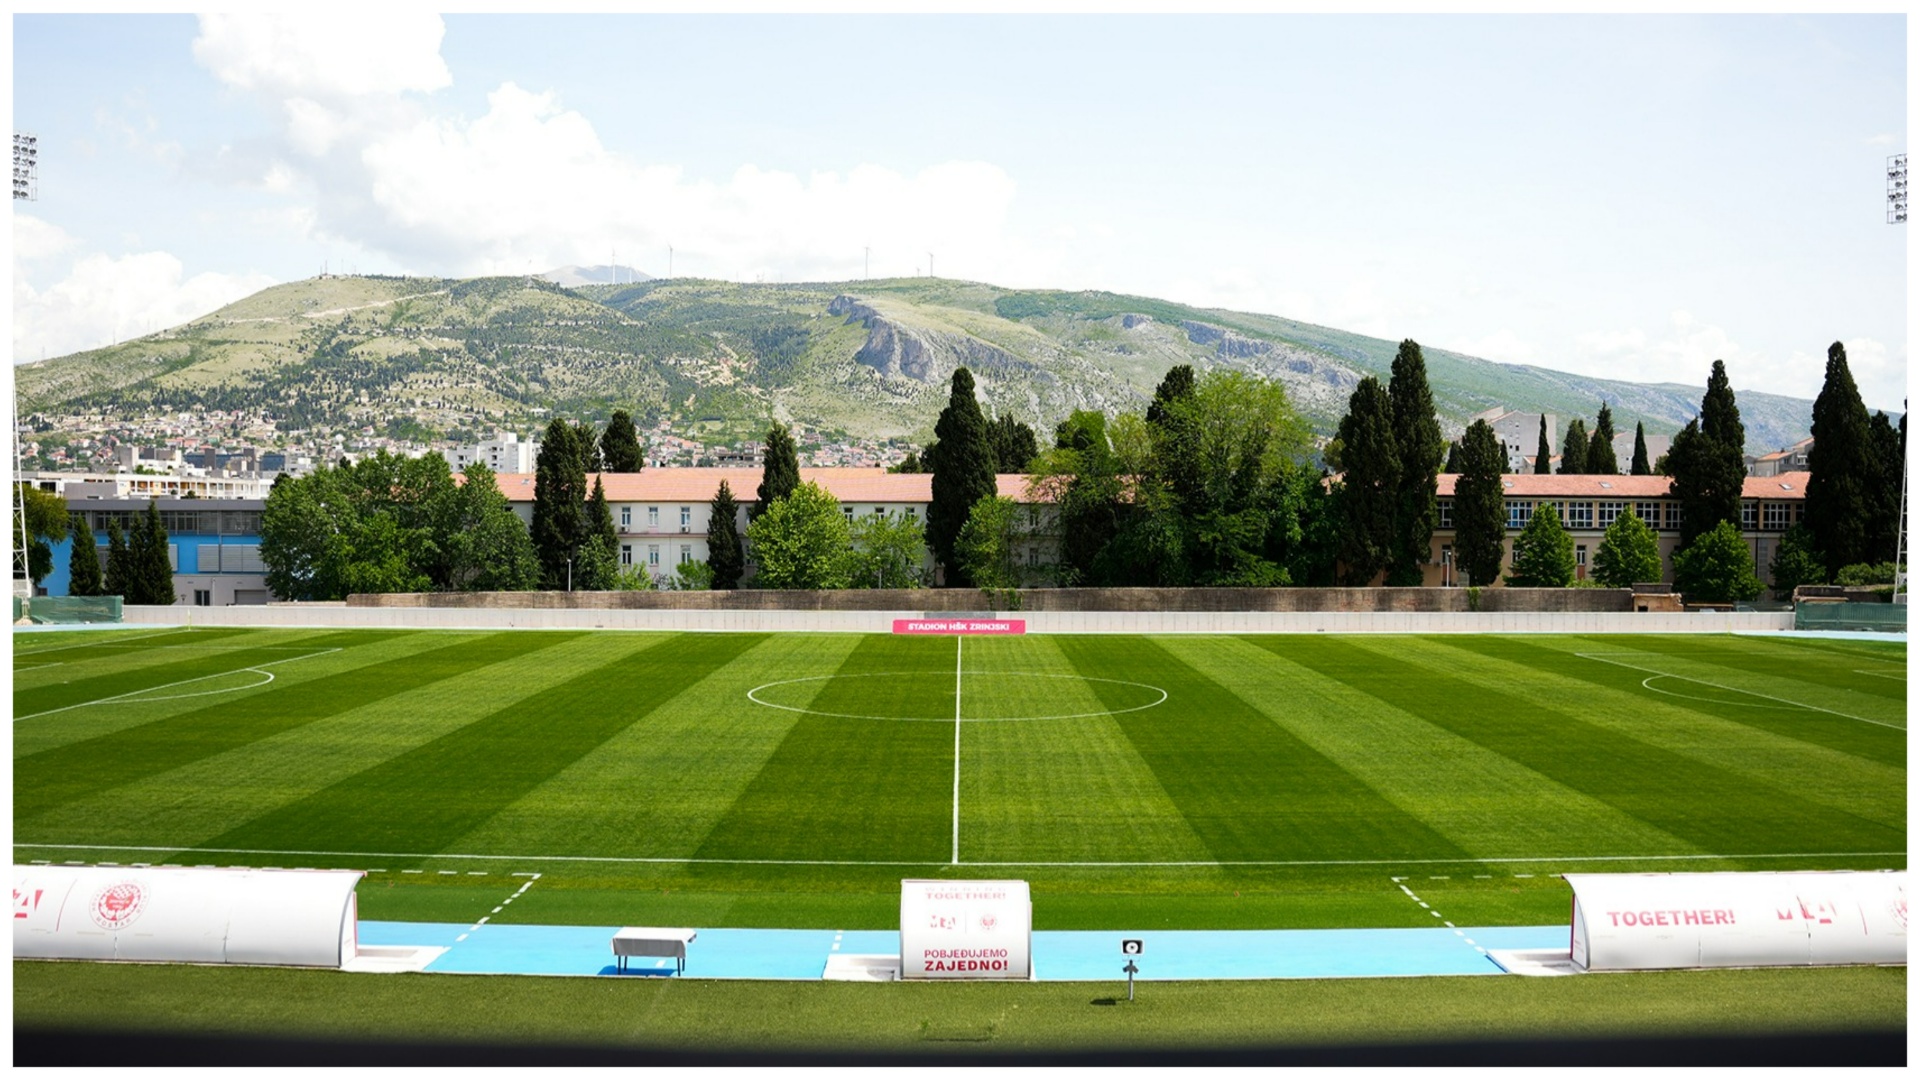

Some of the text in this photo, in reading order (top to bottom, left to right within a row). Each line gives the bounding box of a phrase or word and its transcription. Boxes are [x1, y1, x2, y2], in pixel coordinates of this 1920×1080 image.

[908, 621, 1010, 631] STADION HŠK ZRINJSKI
[925, 892, 1006, 900] TOGETHER!
[1606, 909, 1736, 928] TOGETHER!
[924, 947, 1008, 959] POBJEĐUJEMO
[924, 960, 1008, 972] ZAJEDNO!
